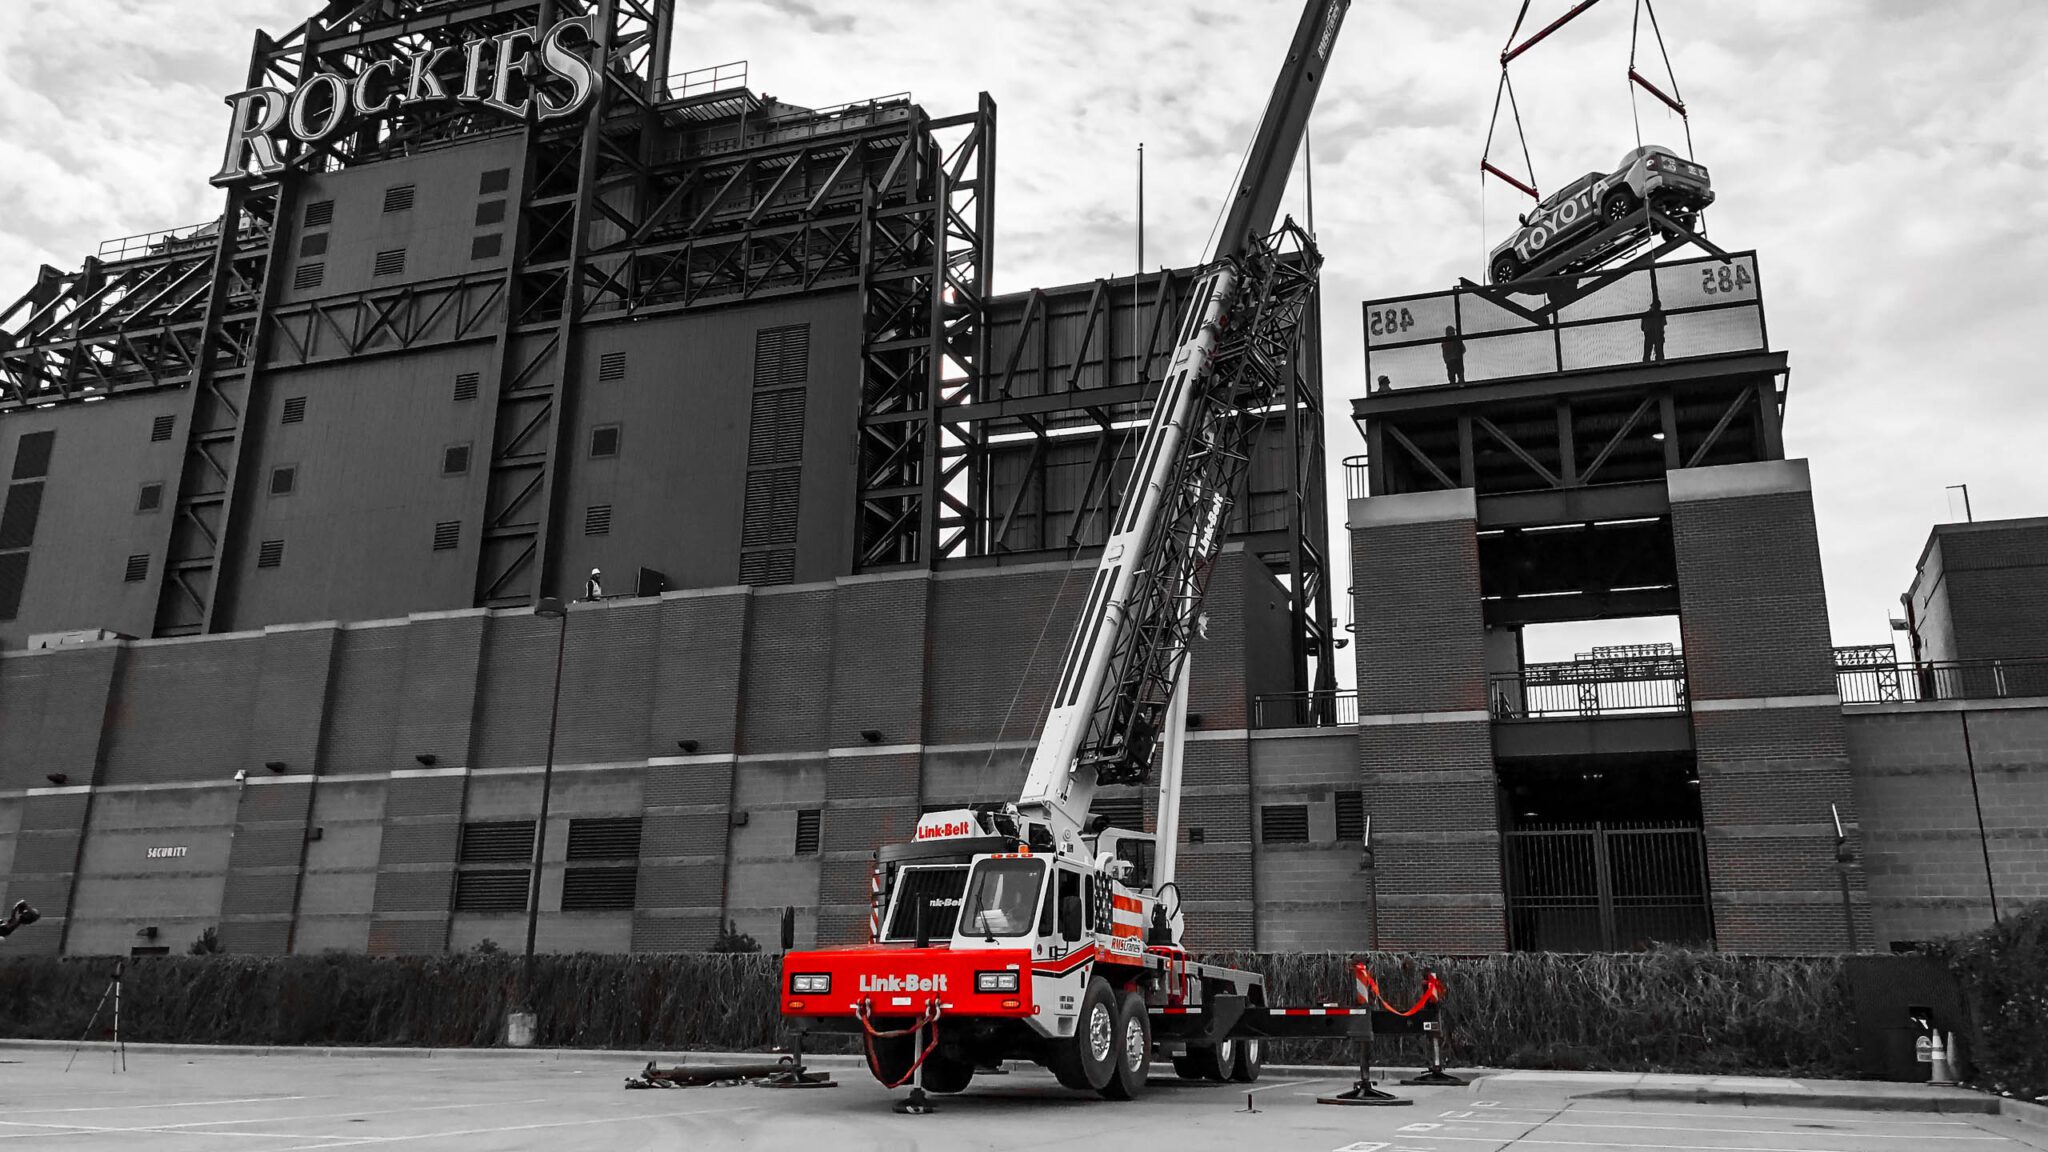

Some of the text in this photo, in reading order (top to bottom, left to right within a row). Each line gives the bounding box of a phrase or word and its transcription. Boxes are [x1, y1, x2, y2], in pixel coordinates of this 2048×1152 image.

[209, 14, 597, 188] ROCKIES
[1515, 180, 1610, 260] TOYOTA
[147, 846, 187, 858] SECURITY
[859, 974, 947, 992] Link-Belt
